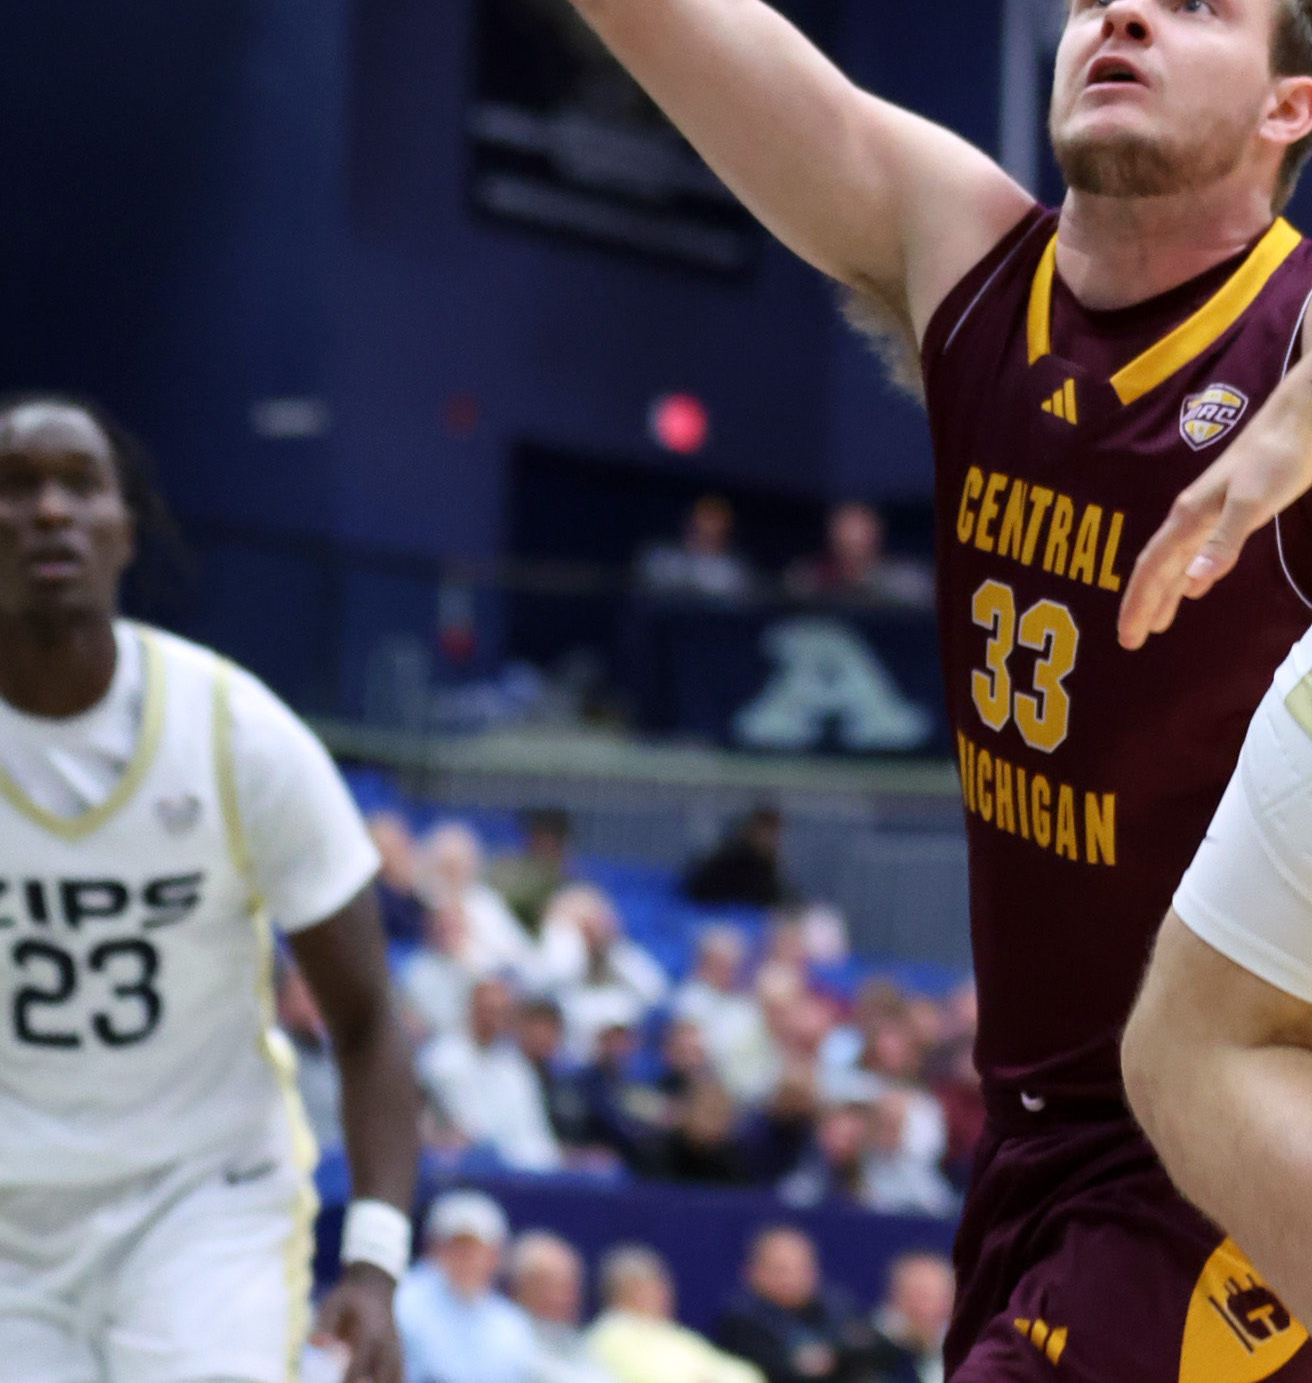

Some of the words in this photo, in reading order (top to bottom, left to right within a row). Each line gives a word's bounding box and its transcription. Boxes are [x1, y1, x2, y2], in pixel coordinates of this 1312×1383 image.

[956, 465, 1125, 592] CENTRAL
[970, 578, 1079, 754] 33
[0, 871, 204, 930] IPS
[13, 937, 163, 1049] 23
